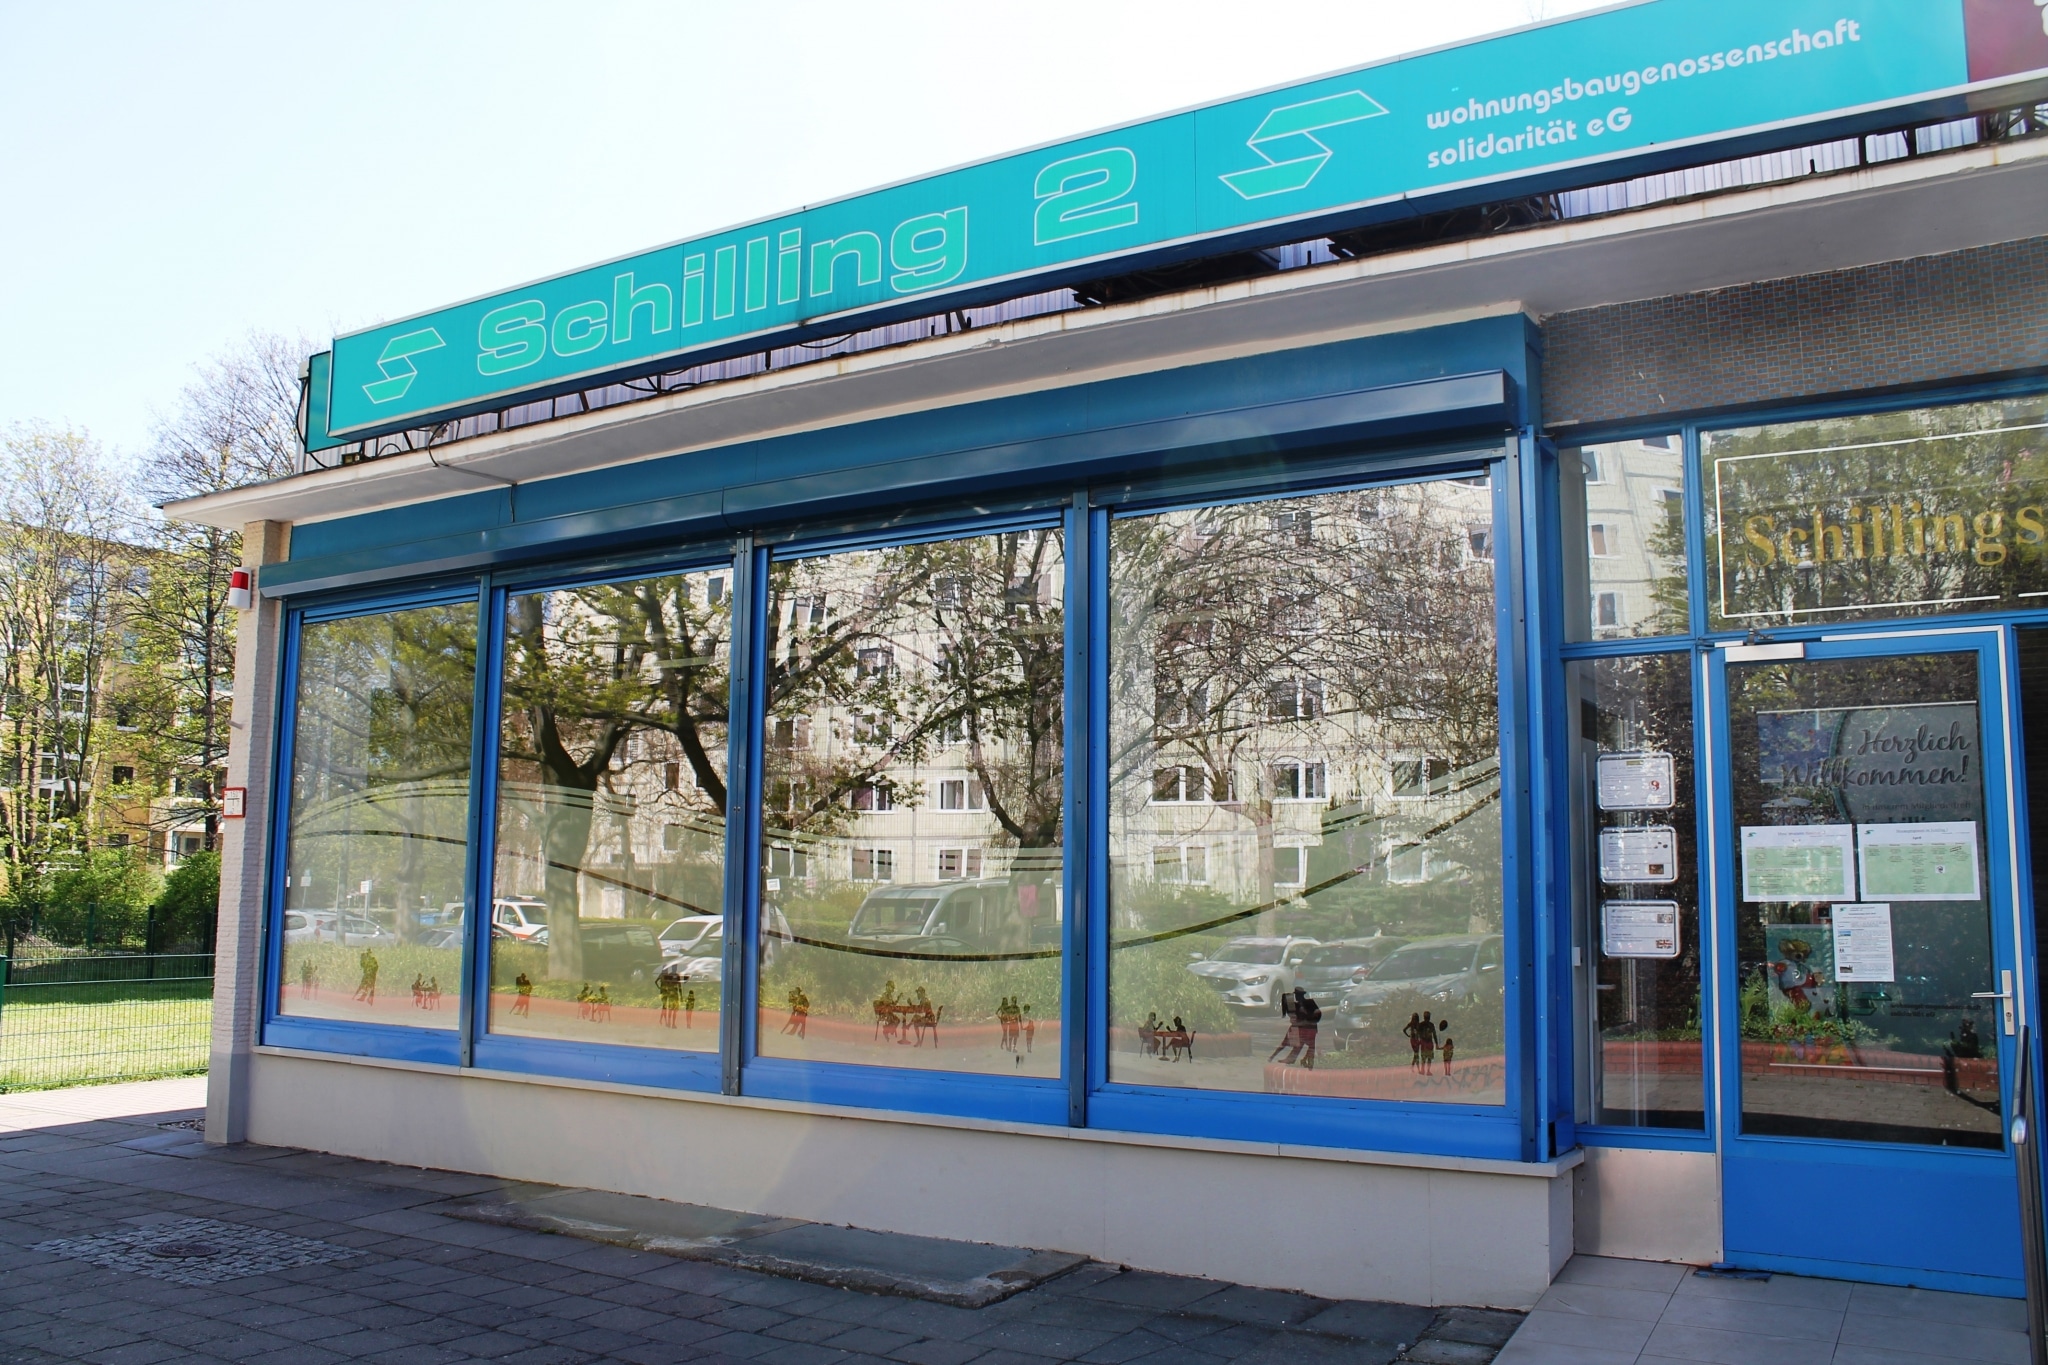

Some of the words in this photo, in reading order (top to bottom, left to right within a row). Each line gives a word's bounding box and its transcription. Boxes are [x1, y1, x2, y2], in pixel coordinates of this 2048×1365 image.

[1426, 17, 1861, 131] wohnungsbaugenossenschaft
[1426, 116, 1578, 169] solidarität
[1585, 106, 1633, 134] eG
[476, 205, 970, 378] Schilling
[1032, 145, 1140, 248] 2
[1743, 500, 2046, 568] Schillings
[1781, 754, 1969, 790] Willkommen!
[1857, 720, 1971, 764] Herzlich
